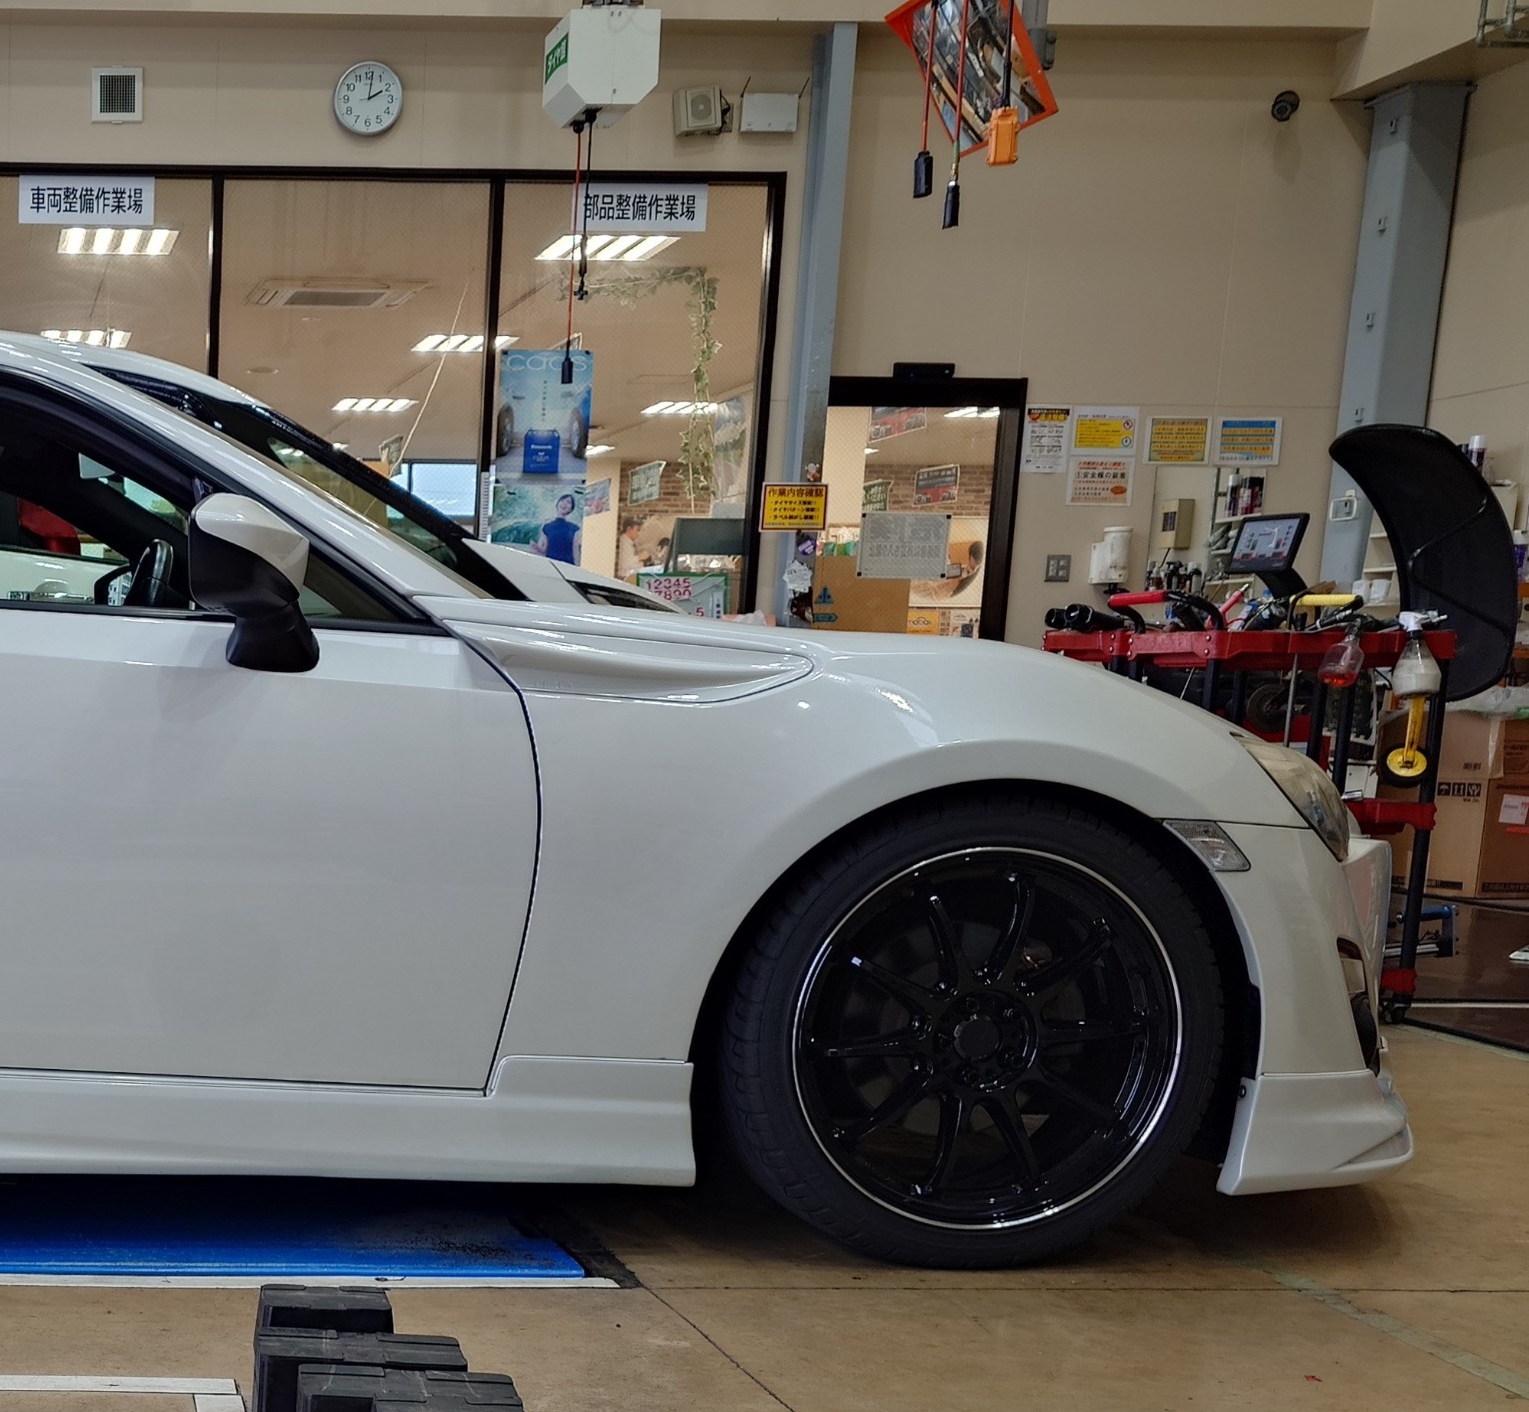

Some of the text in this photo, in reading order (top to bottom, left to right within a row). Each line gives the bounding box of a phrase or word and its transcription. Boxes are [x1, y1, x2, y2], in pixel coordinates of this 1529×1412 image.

[355, 75, 362, 83] 11
[346, 83, 356, 92] 10
[385, 83, 391, 92] 2
[343, 95, 350, 104] 9
[387, 95, 394, 104] 3
[346, 107, 352, 115] 8
[384, 106, 390, 115] 4
[354, 115, 360, 123] 7
[364, 118, 371, 127] 6
[376, 115, 382, 124] 5
[30, 186, 143, 214] 車両整備作業場
[583, 194, 696, 221] 部品整備作業場
[768, 487, 824, 498] 作業内容確認
[646, 577, 691, 591] 12345
[696, 606, 704, 617] 5
